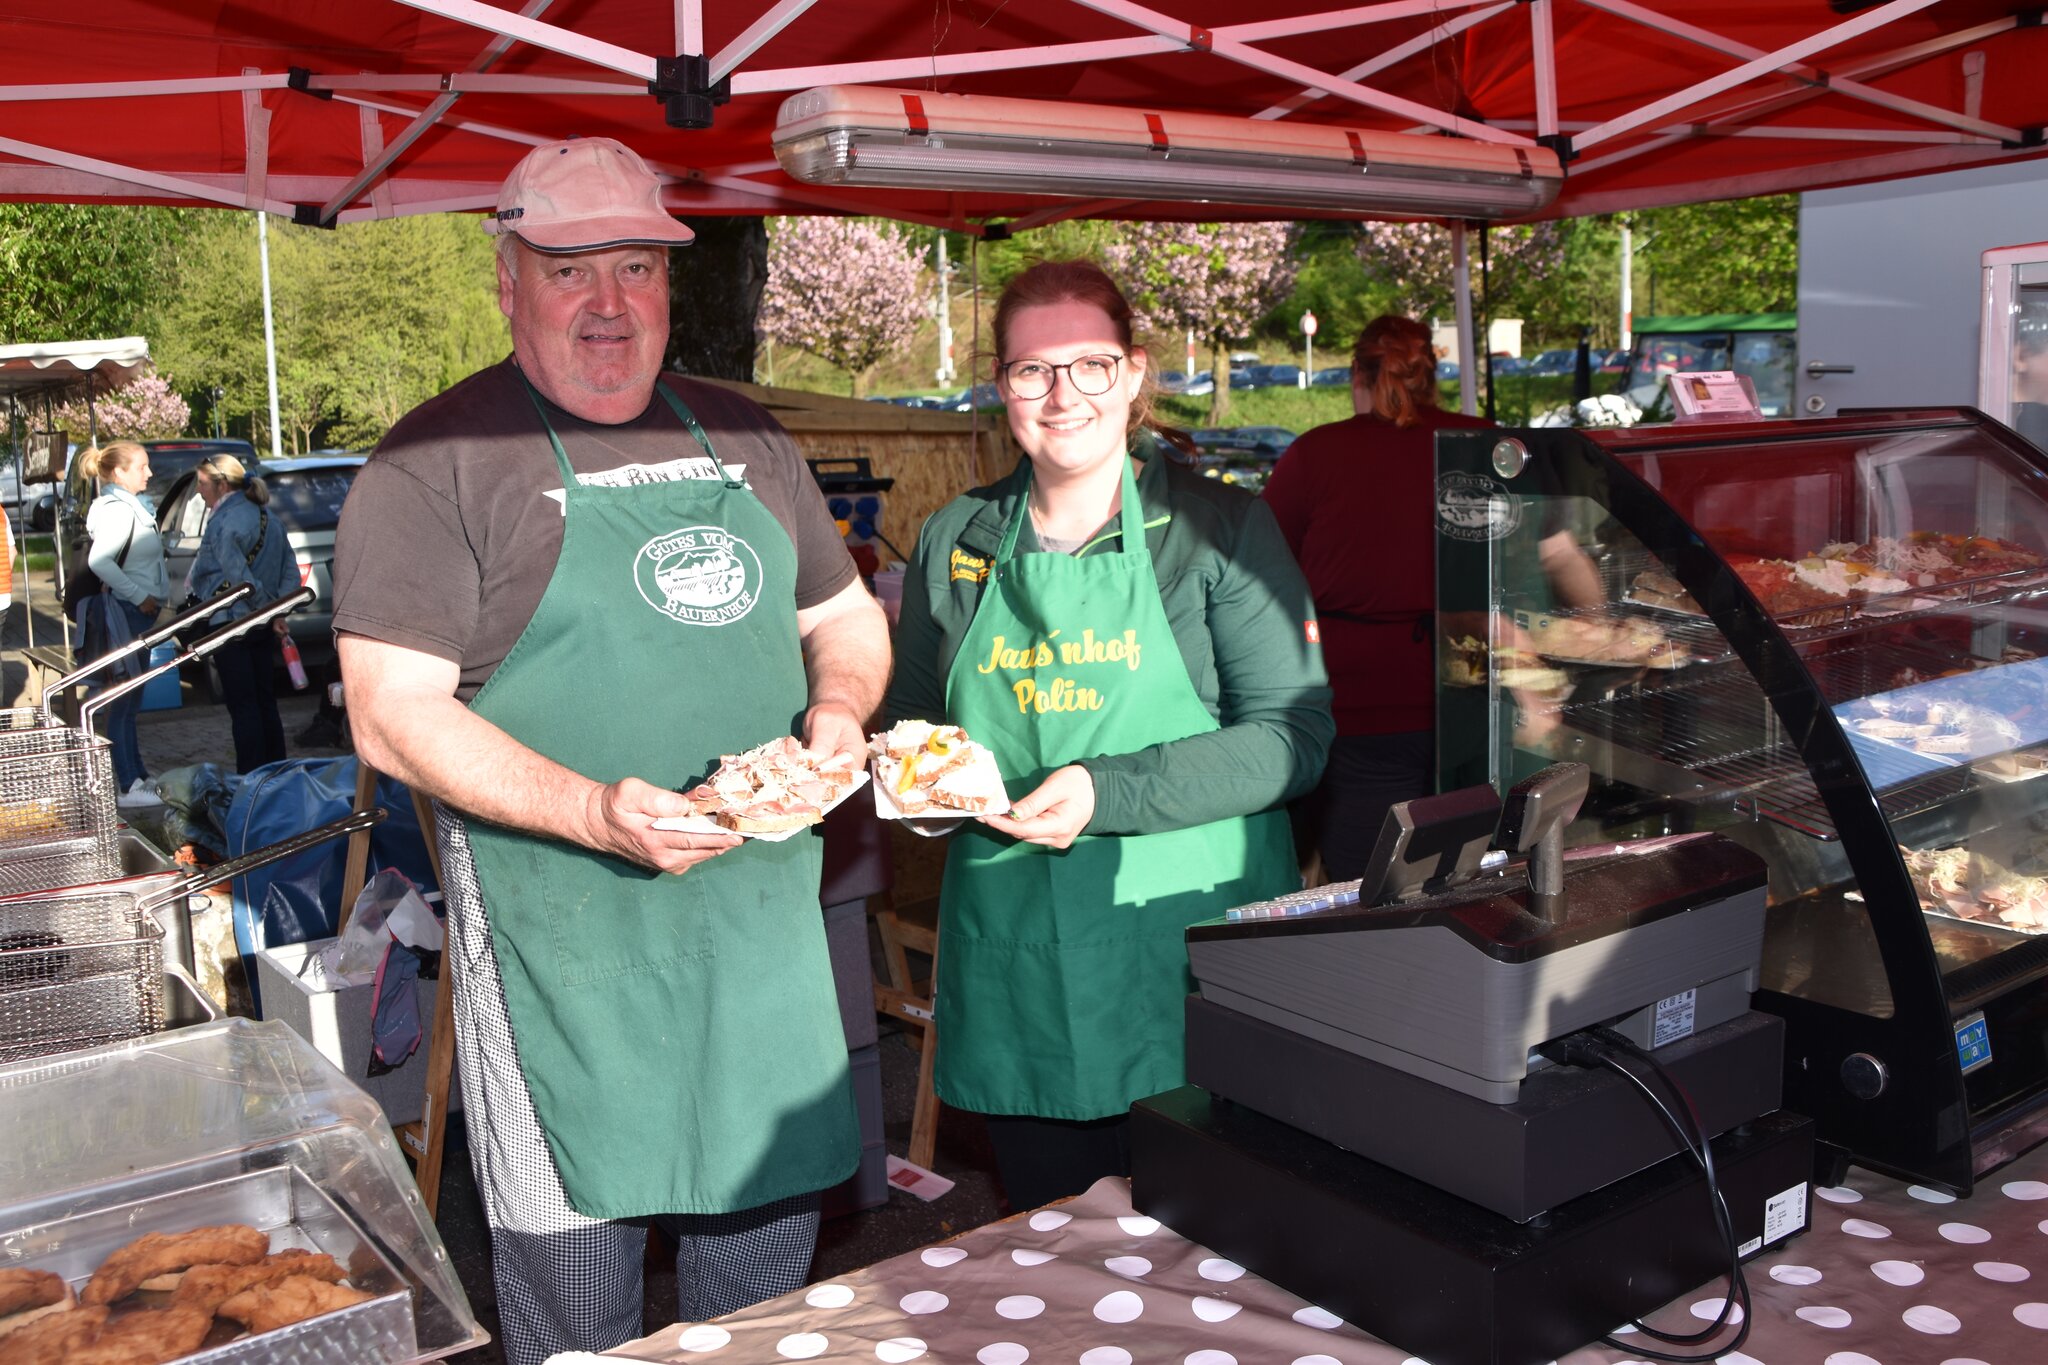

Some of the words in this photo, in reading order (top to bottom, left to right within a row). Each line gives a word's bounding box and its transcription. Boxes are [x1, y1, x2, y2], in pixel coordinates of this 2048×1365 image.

[645, 534, 696, 561] GUTES
[700, 532, 735, 554] VOM
[662, 590, 752, 622] BAUERNHOF
[1012, 677, 1104, 714] Polin
